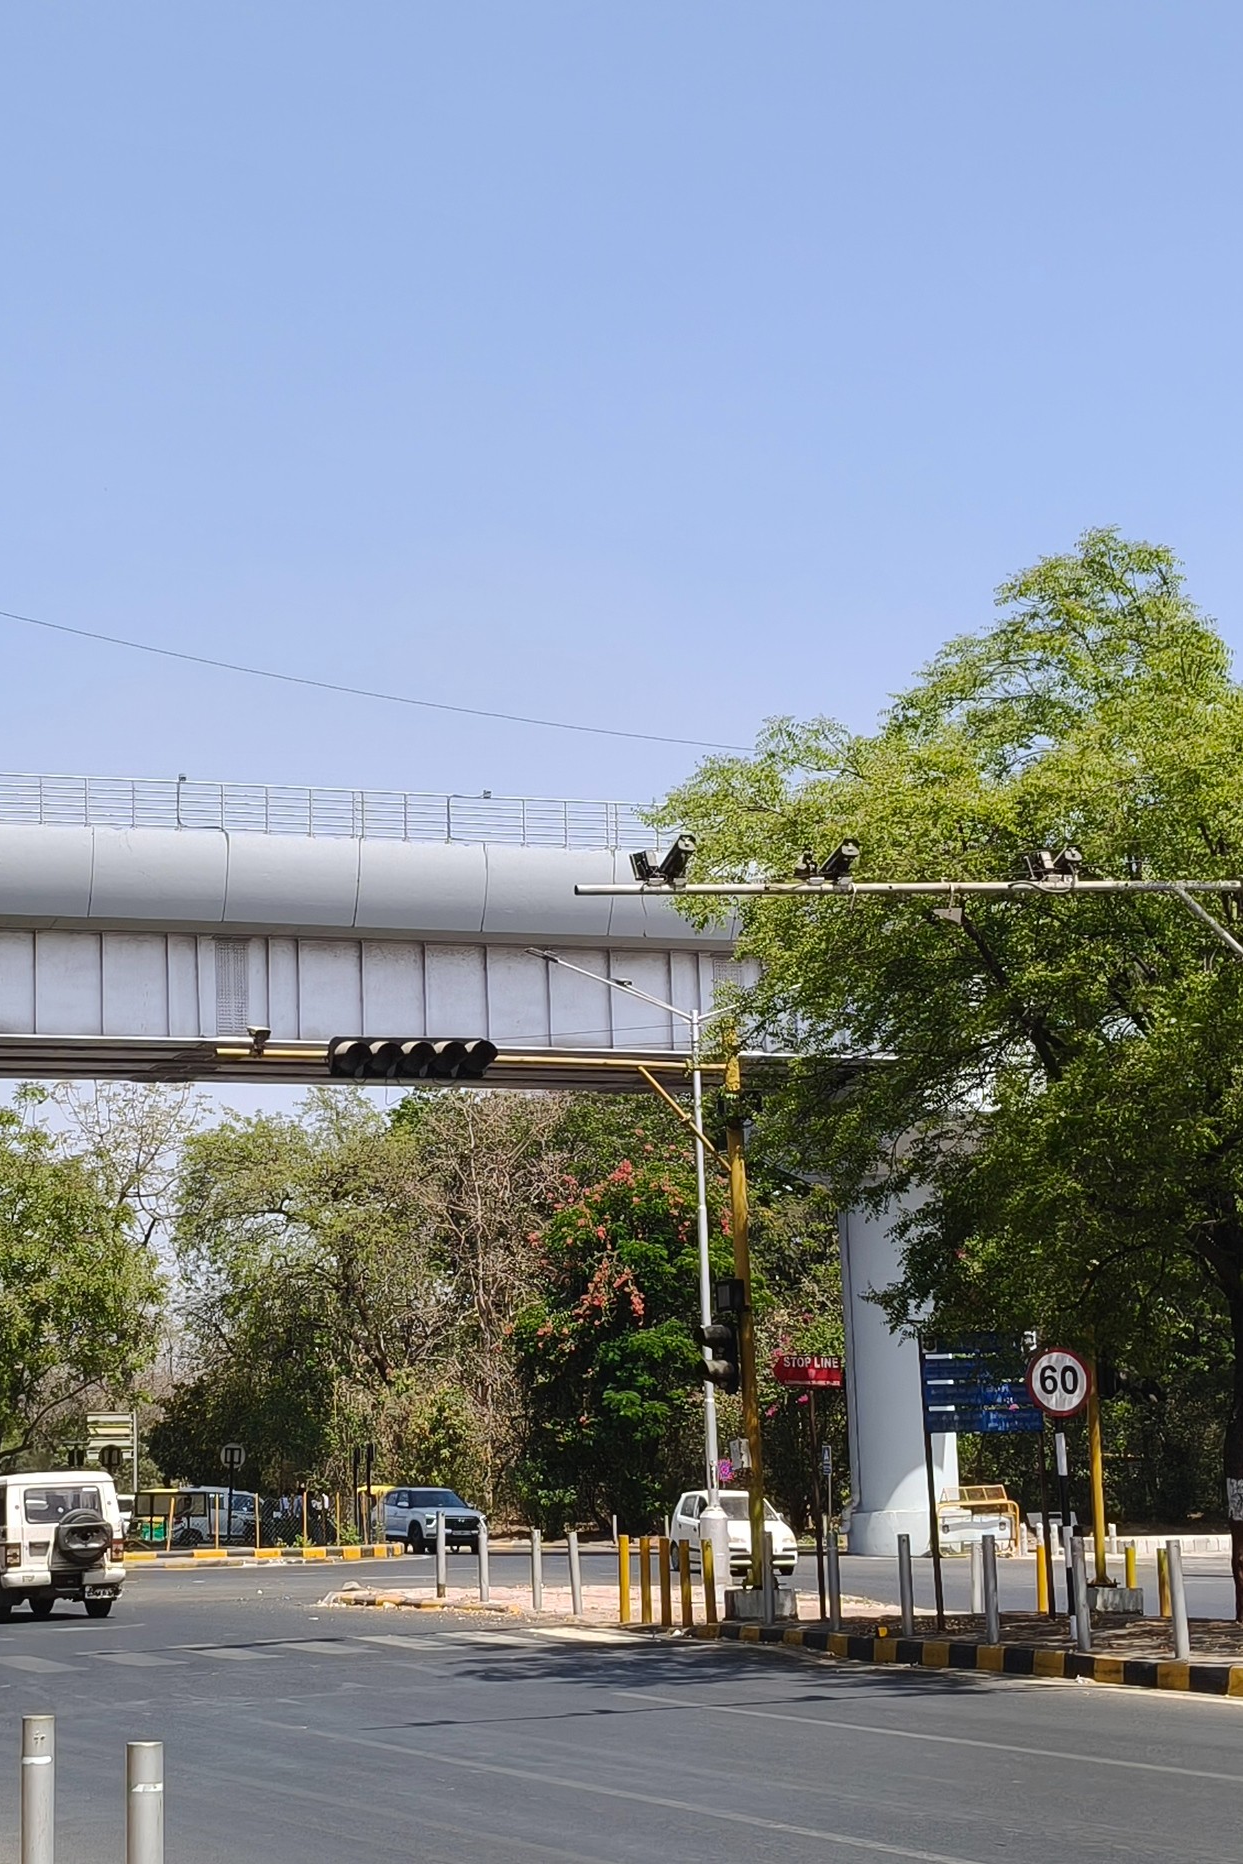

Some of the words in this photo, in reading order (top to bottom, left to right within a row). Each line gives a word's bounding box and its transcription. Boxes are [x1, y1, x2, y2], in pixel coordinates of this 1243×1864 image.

[783, 1356, 811, 1368] STOP
[814, 1357, 839, 1369] LINE
[1039, 1364, 1079, 1395] 60
